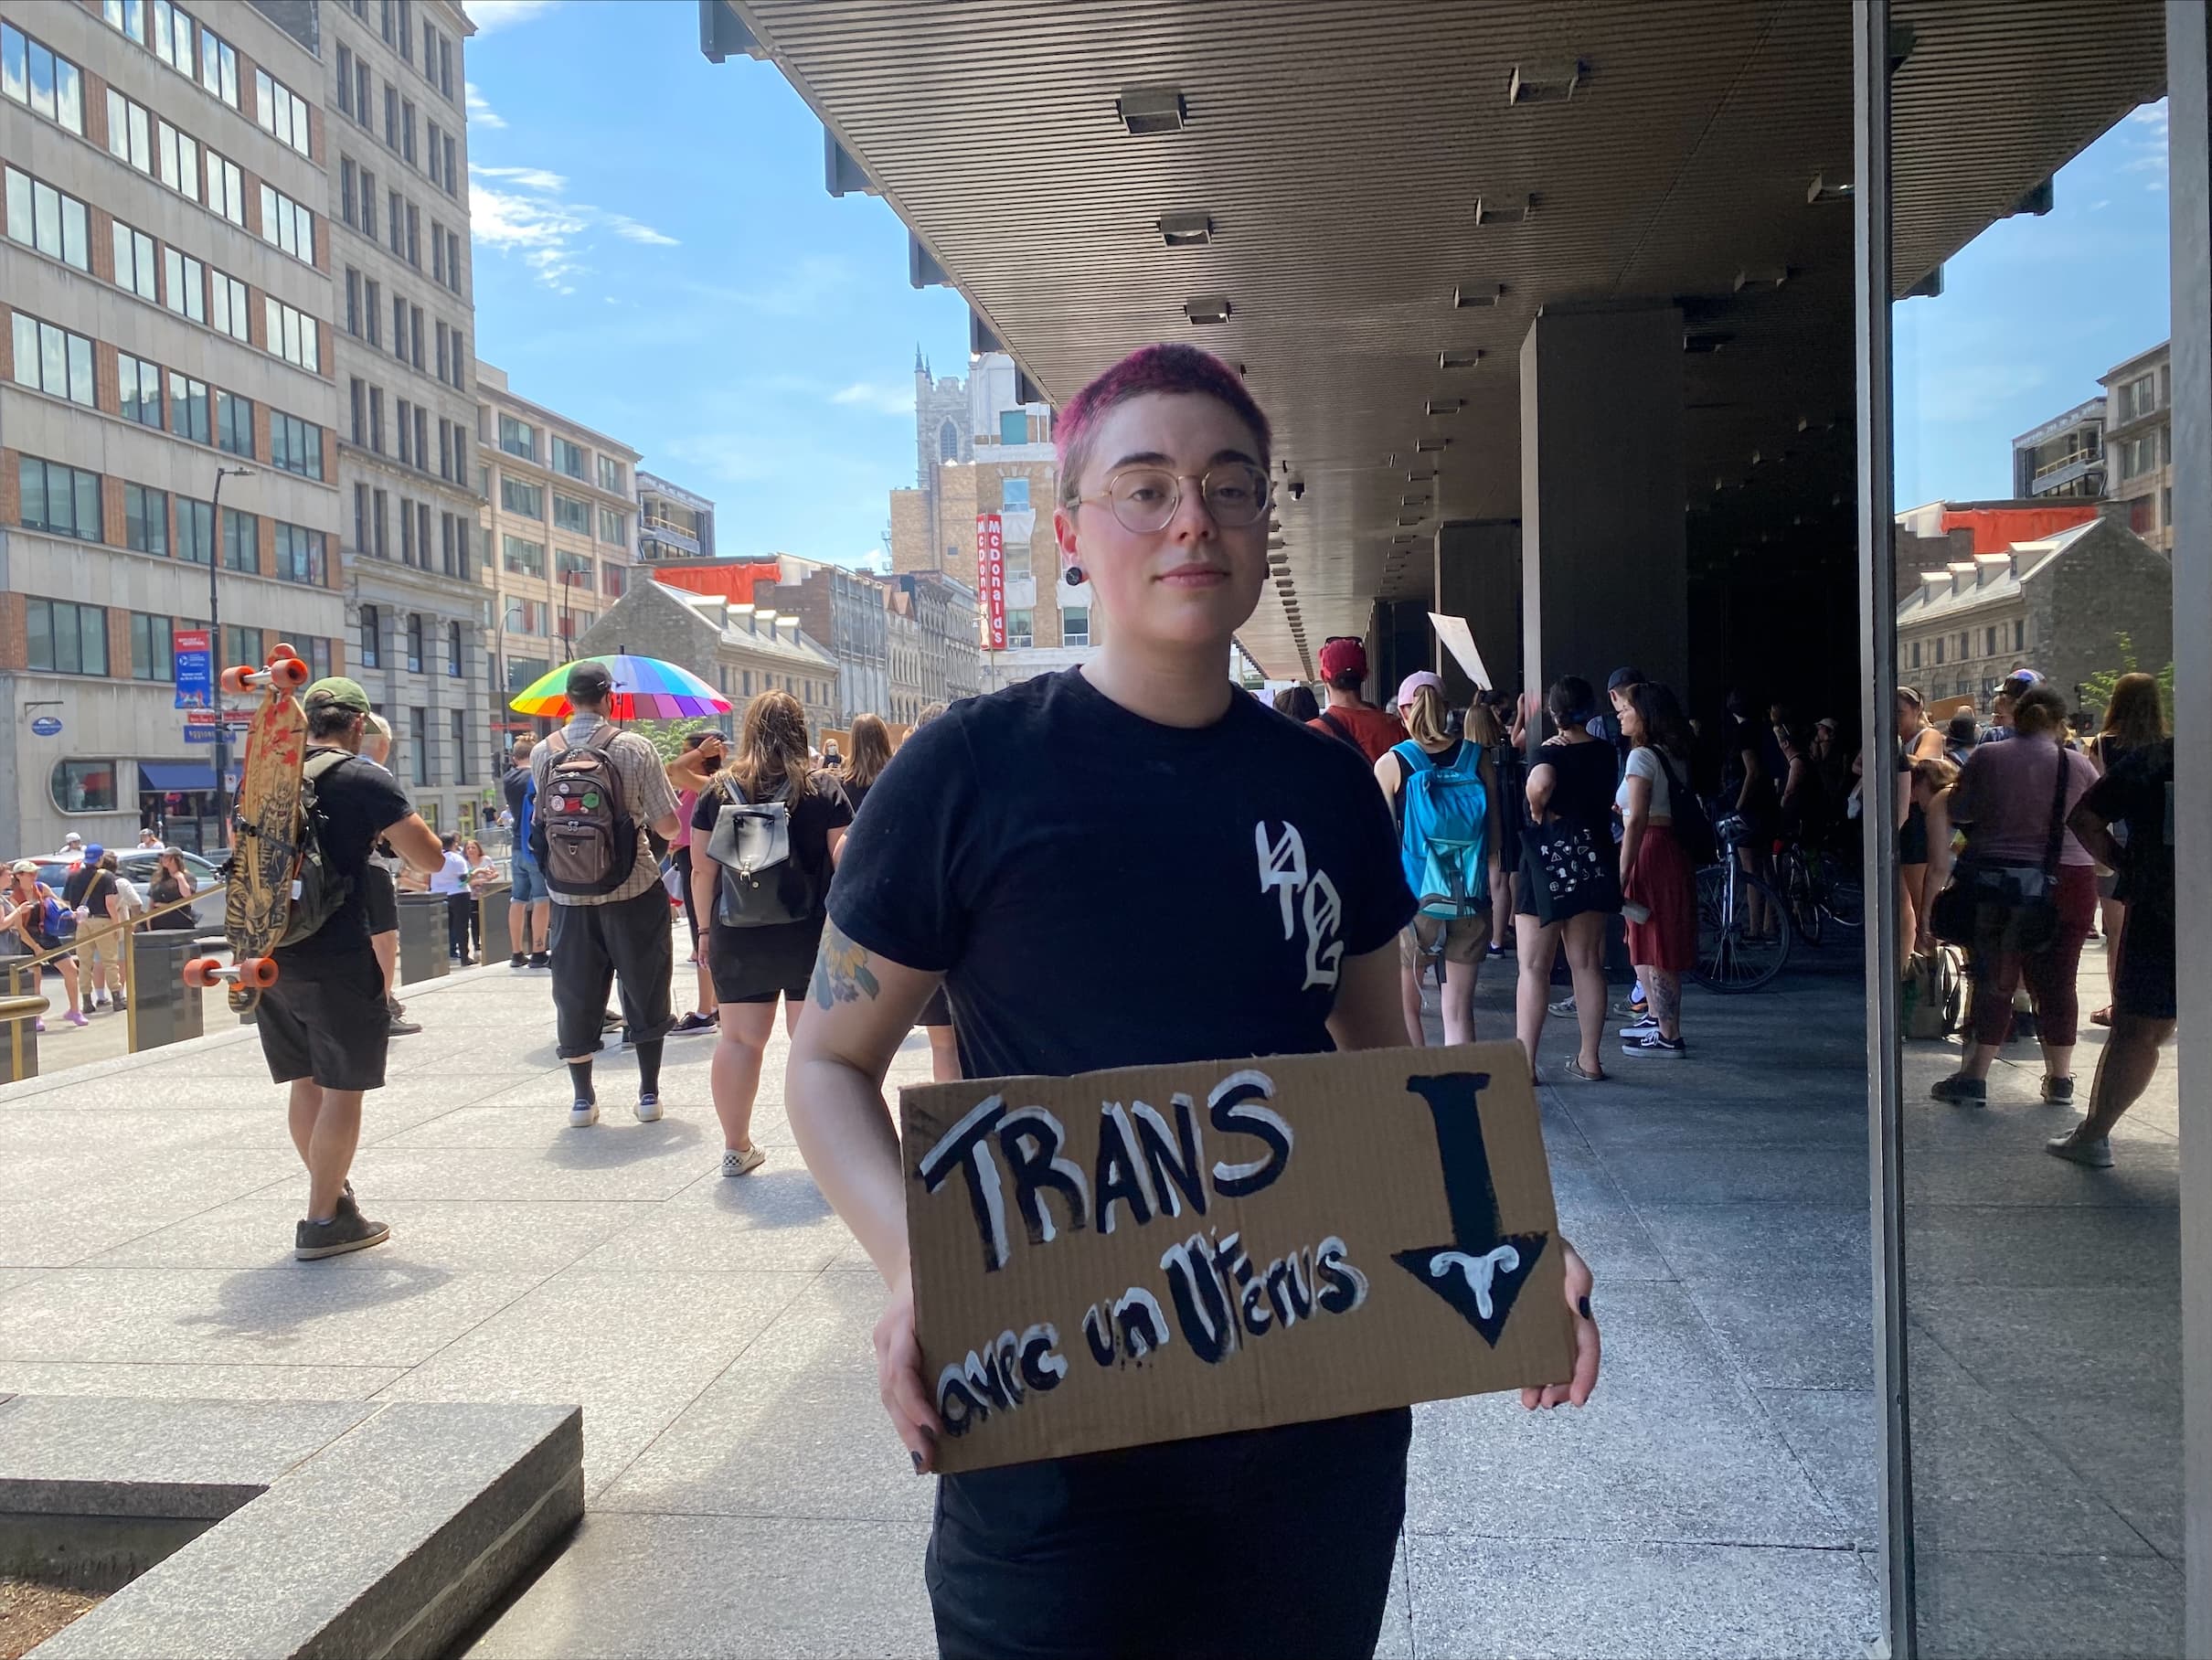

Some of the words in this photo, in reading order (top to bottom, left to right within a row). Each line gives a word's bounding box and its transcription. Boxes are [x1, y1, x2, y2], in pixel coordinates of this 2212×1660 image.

[988, 519, 1003, 644] McDonald's
[920, 1069, 1294, 1272] TRANS
[937, 1323, 1069, 1438] avec
[1082, 1287, 1170, 1368] un
